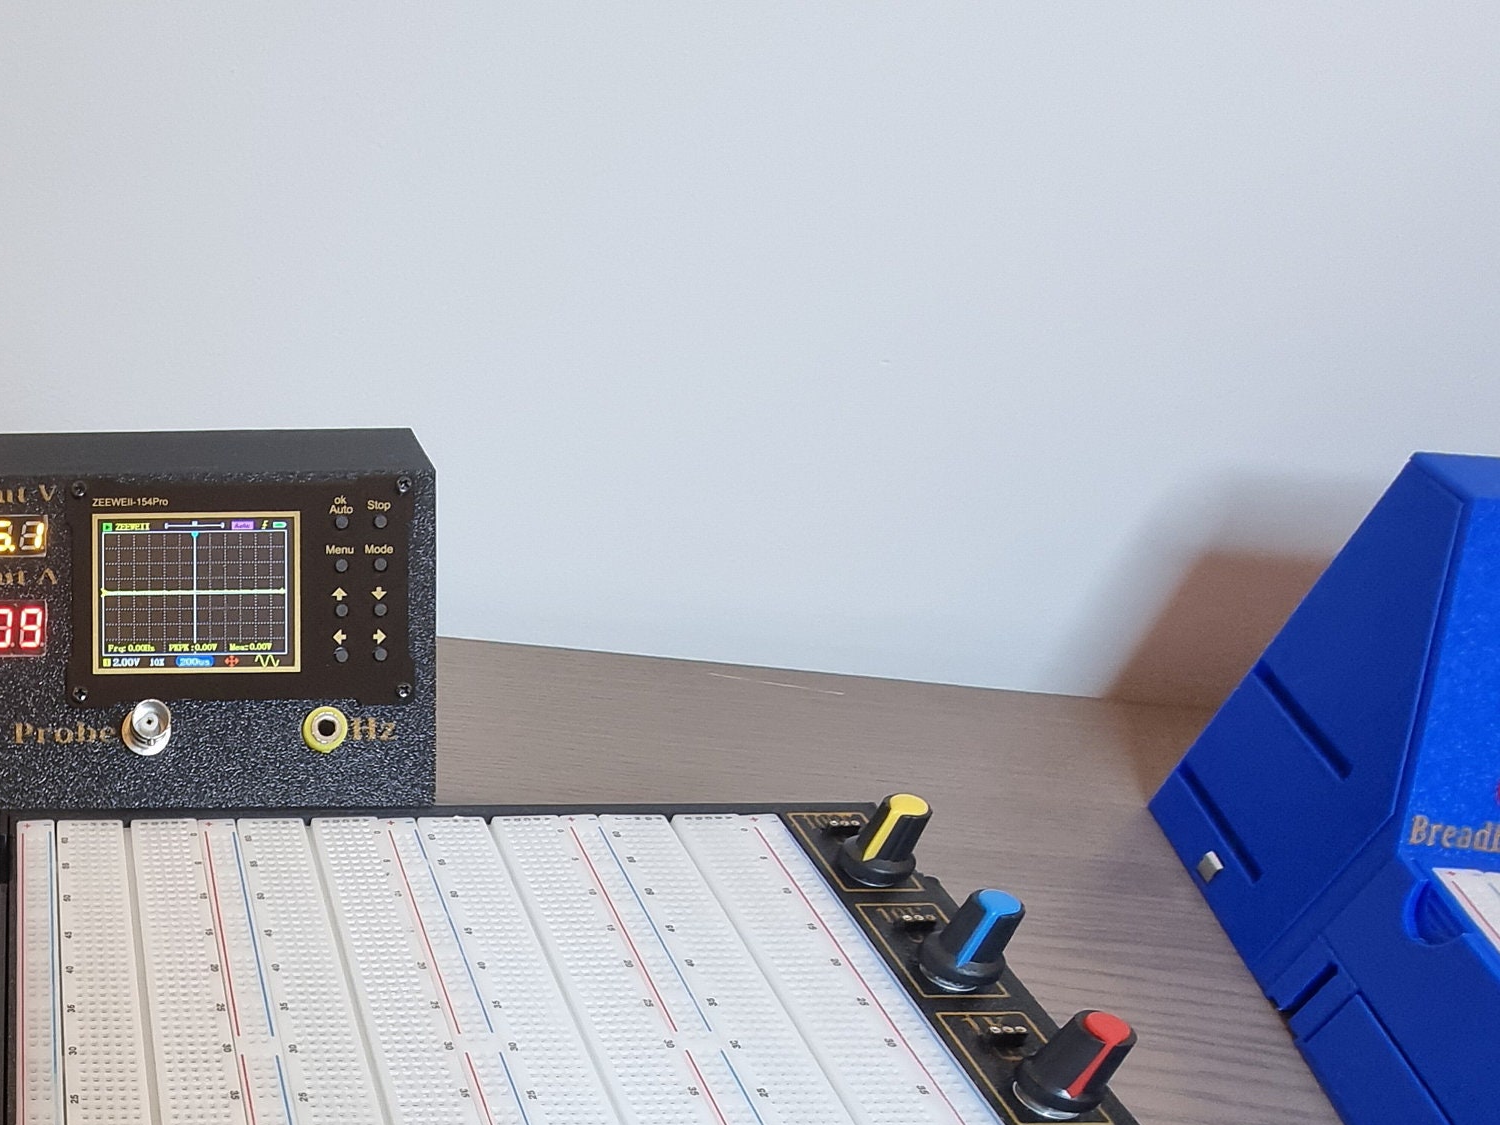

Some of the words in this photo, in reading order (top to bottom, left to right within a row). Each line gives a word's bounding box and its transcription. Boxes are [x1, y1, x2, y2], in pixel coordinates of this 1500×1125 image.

[38, 484, 58, 502] V
[334, 495, 347, 505] ok
[367, 500, 391, 511] Stop
[329, 504, 354, 515] Auto
[325, 545, 354, 555] Menu
[364, 544, 394, 554] Mode
[37, 567, 58, 585] A
[13, 721, 120, 745] Probe
[351, 717, 399, 742] Hz
